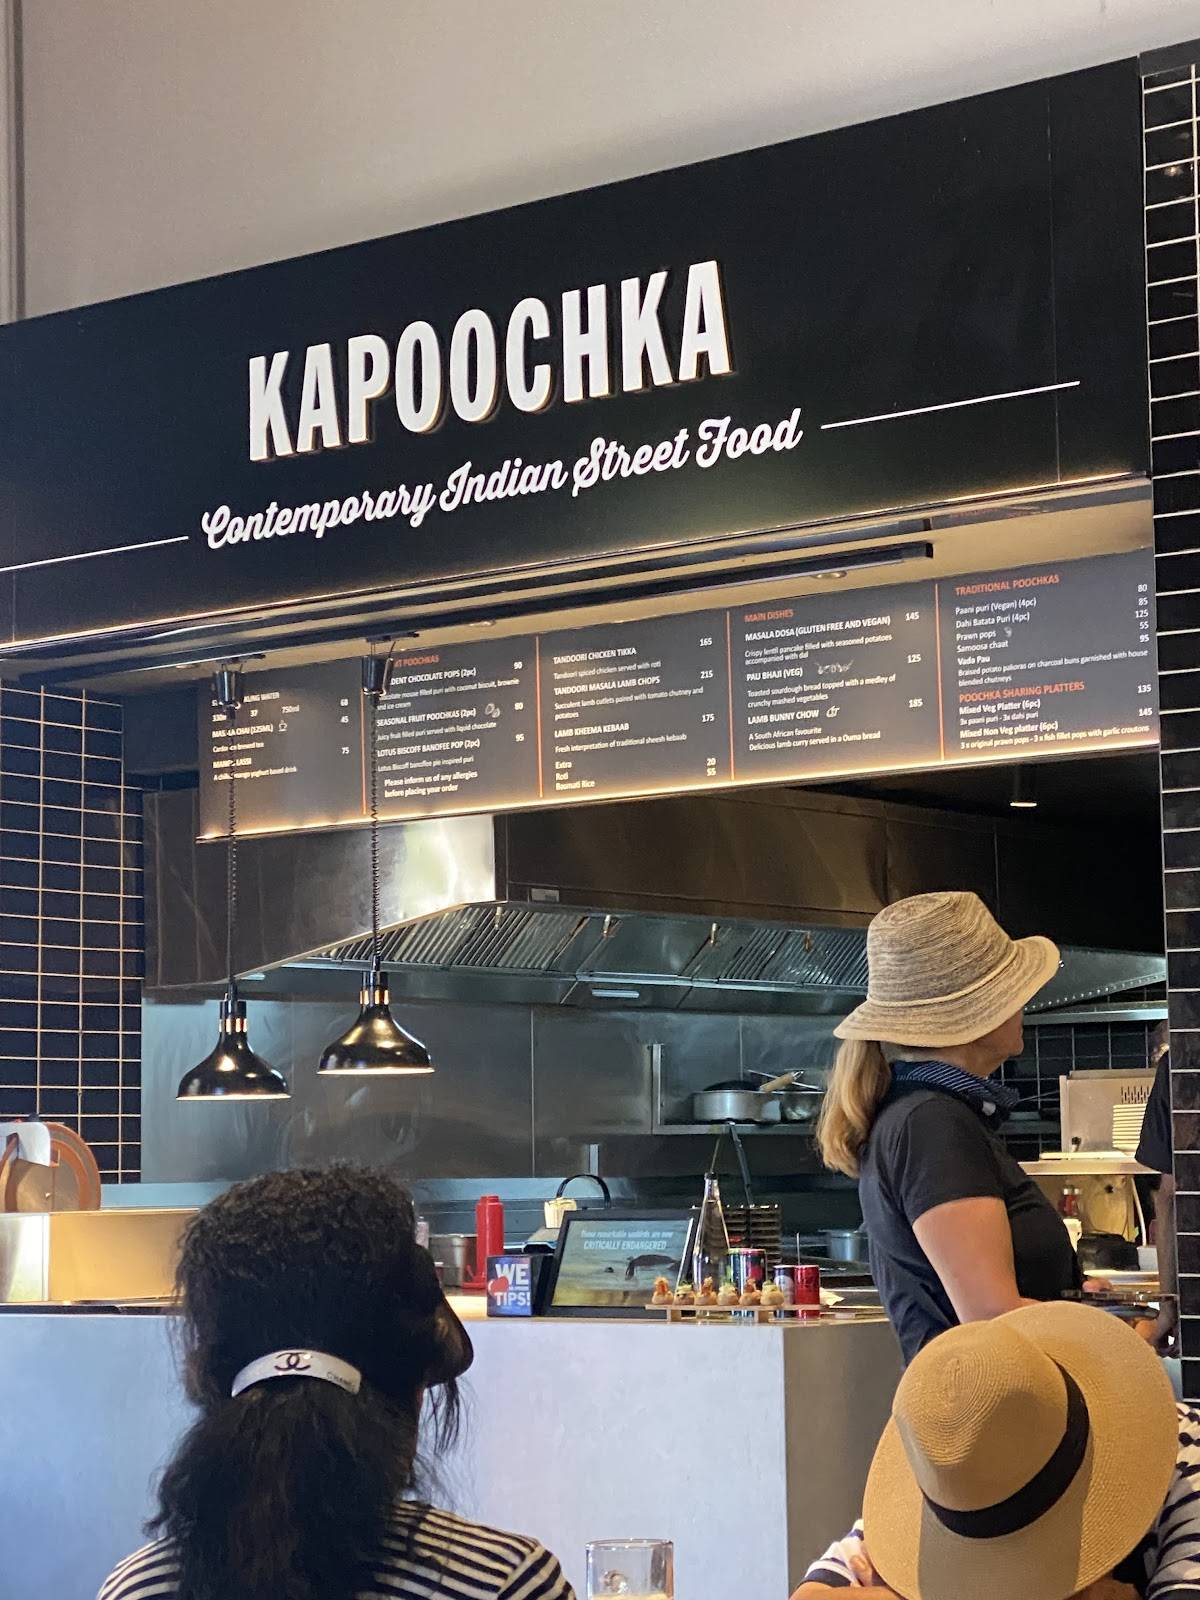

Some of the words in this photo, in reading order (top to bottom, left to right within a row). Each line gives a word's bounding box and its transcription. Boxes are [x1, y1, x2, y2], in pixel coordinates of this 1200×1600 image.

[248, 259, 735, 462] KAPOOCHKA
[201, 478, 438, 550] Contemporary
[440, 457, 569, 513] Indian
[572, 428, 690, 496] Street
[695, 408, 804, 469] Food
[955, 581, 1010, 596] TRADITIONAL
[1013, 575, 1059, 588] POOCHKAS
[975, 604, 989, 613] puri
[991, 600, 1016, 612] (Vegan)
[1018, 597, 1036, 608] (4pc)
[1138, 584, 1147, 592] 80
[744, 613, 766, 622] MAIN
[767, 609, 794, 620] DISHES
[956, 619, 972, 628] Dahi
[973, 617, 995, 626] Batata
[997, 615, 1011, 623] Puri
[1012, 612, 1030, 622] (4pc)
[745, 632, 775, 641] MASALA
[776, 628, 795, 638] DOSA
[796, 624, 826, 636] (GLUTEN
[827, 622, 843, 631] FREE
[845, 619, 861, 629] AND
[862, 616, 890, 627] VEGAN)
[905, 612, 919, 621] 145
[956, 632, 978, 641] Prawn
[979, 630, 996, 639] pops
[1136, 609, 1148, 618] 125
[957, 644, 988, 652] Samoosa
[989, 640, 1008, 648] chaat
[1140, 621, 1149, 629] 55
[554, 653, 587, 664] TANDOORI
[588, 650, 616, 660] CHICKEN
[618, 647, 636, 656] TIKKA
[745, 649, 762, 658] Crispy
[805, 642, 819, 650] filled
[1037, 658, 1063, 667] charcoal
[1081, 653, 1112, 664] garnished
[1113, 651, 1127, 659] with
[746, 673, 761, 681] PAU
[762, 670, 782, 679] BHAJI
[783, 668, 802, 678] (VEG)
[907, 654, 921, 663] 125
[958, 657, 975, 665] Vada
[408, 672, 442, 682] CHOCOLATE
[444, 670, 460, 678] POPS
[461, 668, 476, 678] (2pc)
[554, 685, 588, 695] TANDOORI
[589, 681, 616, 691] MASALA
[618, 679, 636, 688] LAMB
[638, 676, 660, 685] CHOPS
[700, 670, 713, 678] 215
[804, 684, 821, 692] bread
[822, 681, 844, 690] topped
[889, 674, 896, 682] of
[959, 706, 981, 714] Mixed
[983, 704, 996, 713] Veg
[997, 702, 1021, 711] Platter
[1022, 699, 1040, 709] (6pc)
[1137, 684, 1151, 693] 135
[960, 690, 1001, 702] POOCHKA
[1003, 687, 1041, 697] SHARING
[1044, 681, 1084, 693] PLATTERS
[377, 716, 407, 726] SEASONAL
[408, 712, 425, 723] FRUIT
[461, 708, 476, 718] (2pc)
[748, 715, 768, 724] LAMB
[770, 712, 794, 722] BUNNY
[796, 709, 819, 719] CHOW
[960, 729, 982, 738] Mixed
[999, 727, 1013, 735] Veg
[1014, 725, 1039, 734] platter
[1040, 721, 1058, 732] (6pc)
[1139, 708, 1152, 716] 145
[554, 729, 574, 738] LAMB
[702, 714, 714, 722] 175
[755, 731, 772, 739] South
[773, 728, 794, 738] African
[1072, 730, 1087, 740] pops
[1121, 725, 1149, 734] croutons
[378, 749, 396, 757] LOTUS
[397, 746, 420, 755] BISCOFF
[451, 741, 463, 749] POP
[465, 739, 480, 748] (2pc)
[609, 740, 615, 748] of
[749, 742, 776, 751] Delicious
[793, 739, 808, 748] curry
[809, 736, 829, 745] served
[862, 731, 881, 739] bread
[555, 761, 572, 769] Extra
[384, 778, 403, 786] Please
[404, 776, 424, 784] inform
[452, 771, 478, 780] allergies
[582, 780, 595, 788] Rice
[405, 787, 426, 797] placing
[427, 786, 440, 794] your
[442, 784, 458, 792] order
[584, 1240, 619, 1249] CRITICALLY
[622, 1240, 667, 1249] ENDANGERED
[495, 1264, 528, 1285] WE
[494, 1292, 530, 1306] TIPS!
